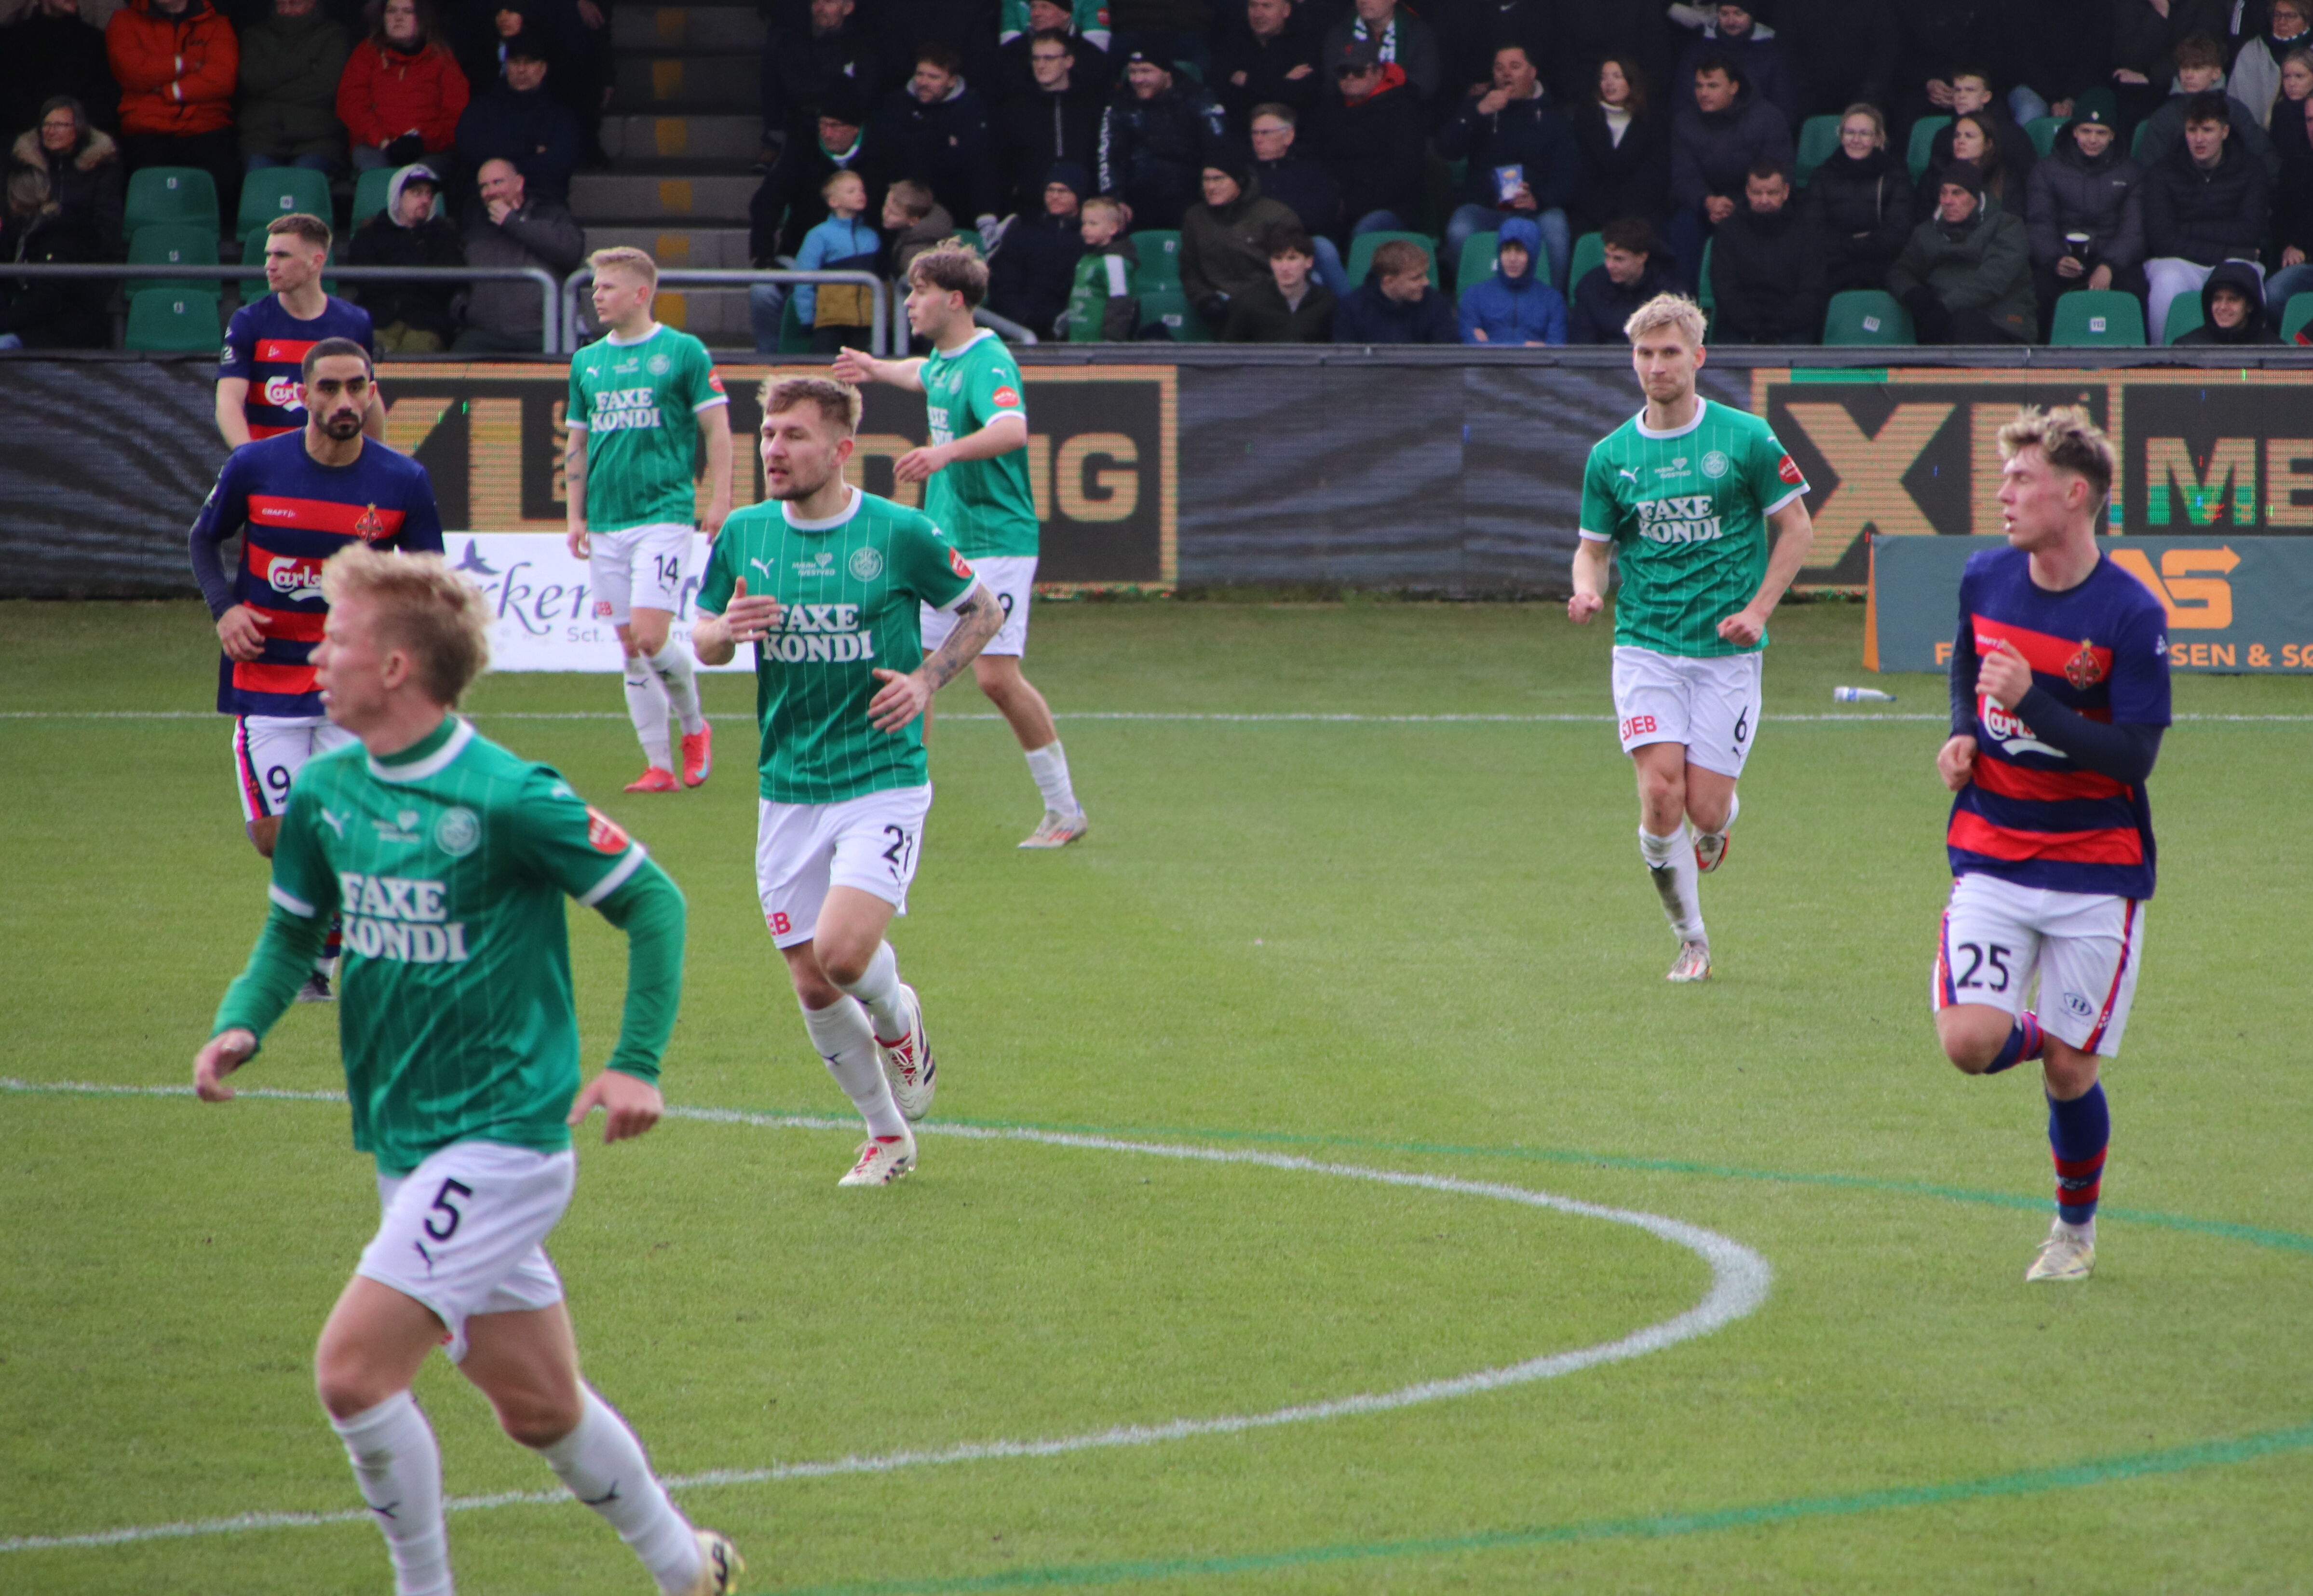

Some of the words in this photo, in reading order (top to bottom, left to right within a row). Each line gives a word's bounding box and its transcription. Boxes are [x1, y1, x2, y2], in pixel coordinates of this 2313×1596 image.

[595, 387, 653, 410] FAXE
[591, 408, 661, 432] KONDI
[1636, 495, 1713, 521] FAXE
[1638, 516, 1723, 543] KONDI
[654, 555, 678, 585] 14
[568, 627, 604, 642] Sct.
[763, 630, 874, 663] KONDI
[2247, 642, 2272, 667] &
[1734, 705, 1748, 743] 6
[267, 766, 291, 804] 9
[339, 871, 447, 922] FAXE
[342, 914, 469, 964] KONDI
[1957, 942, 2011, 992] 25
[424, 1177, 473, 1242] 5
